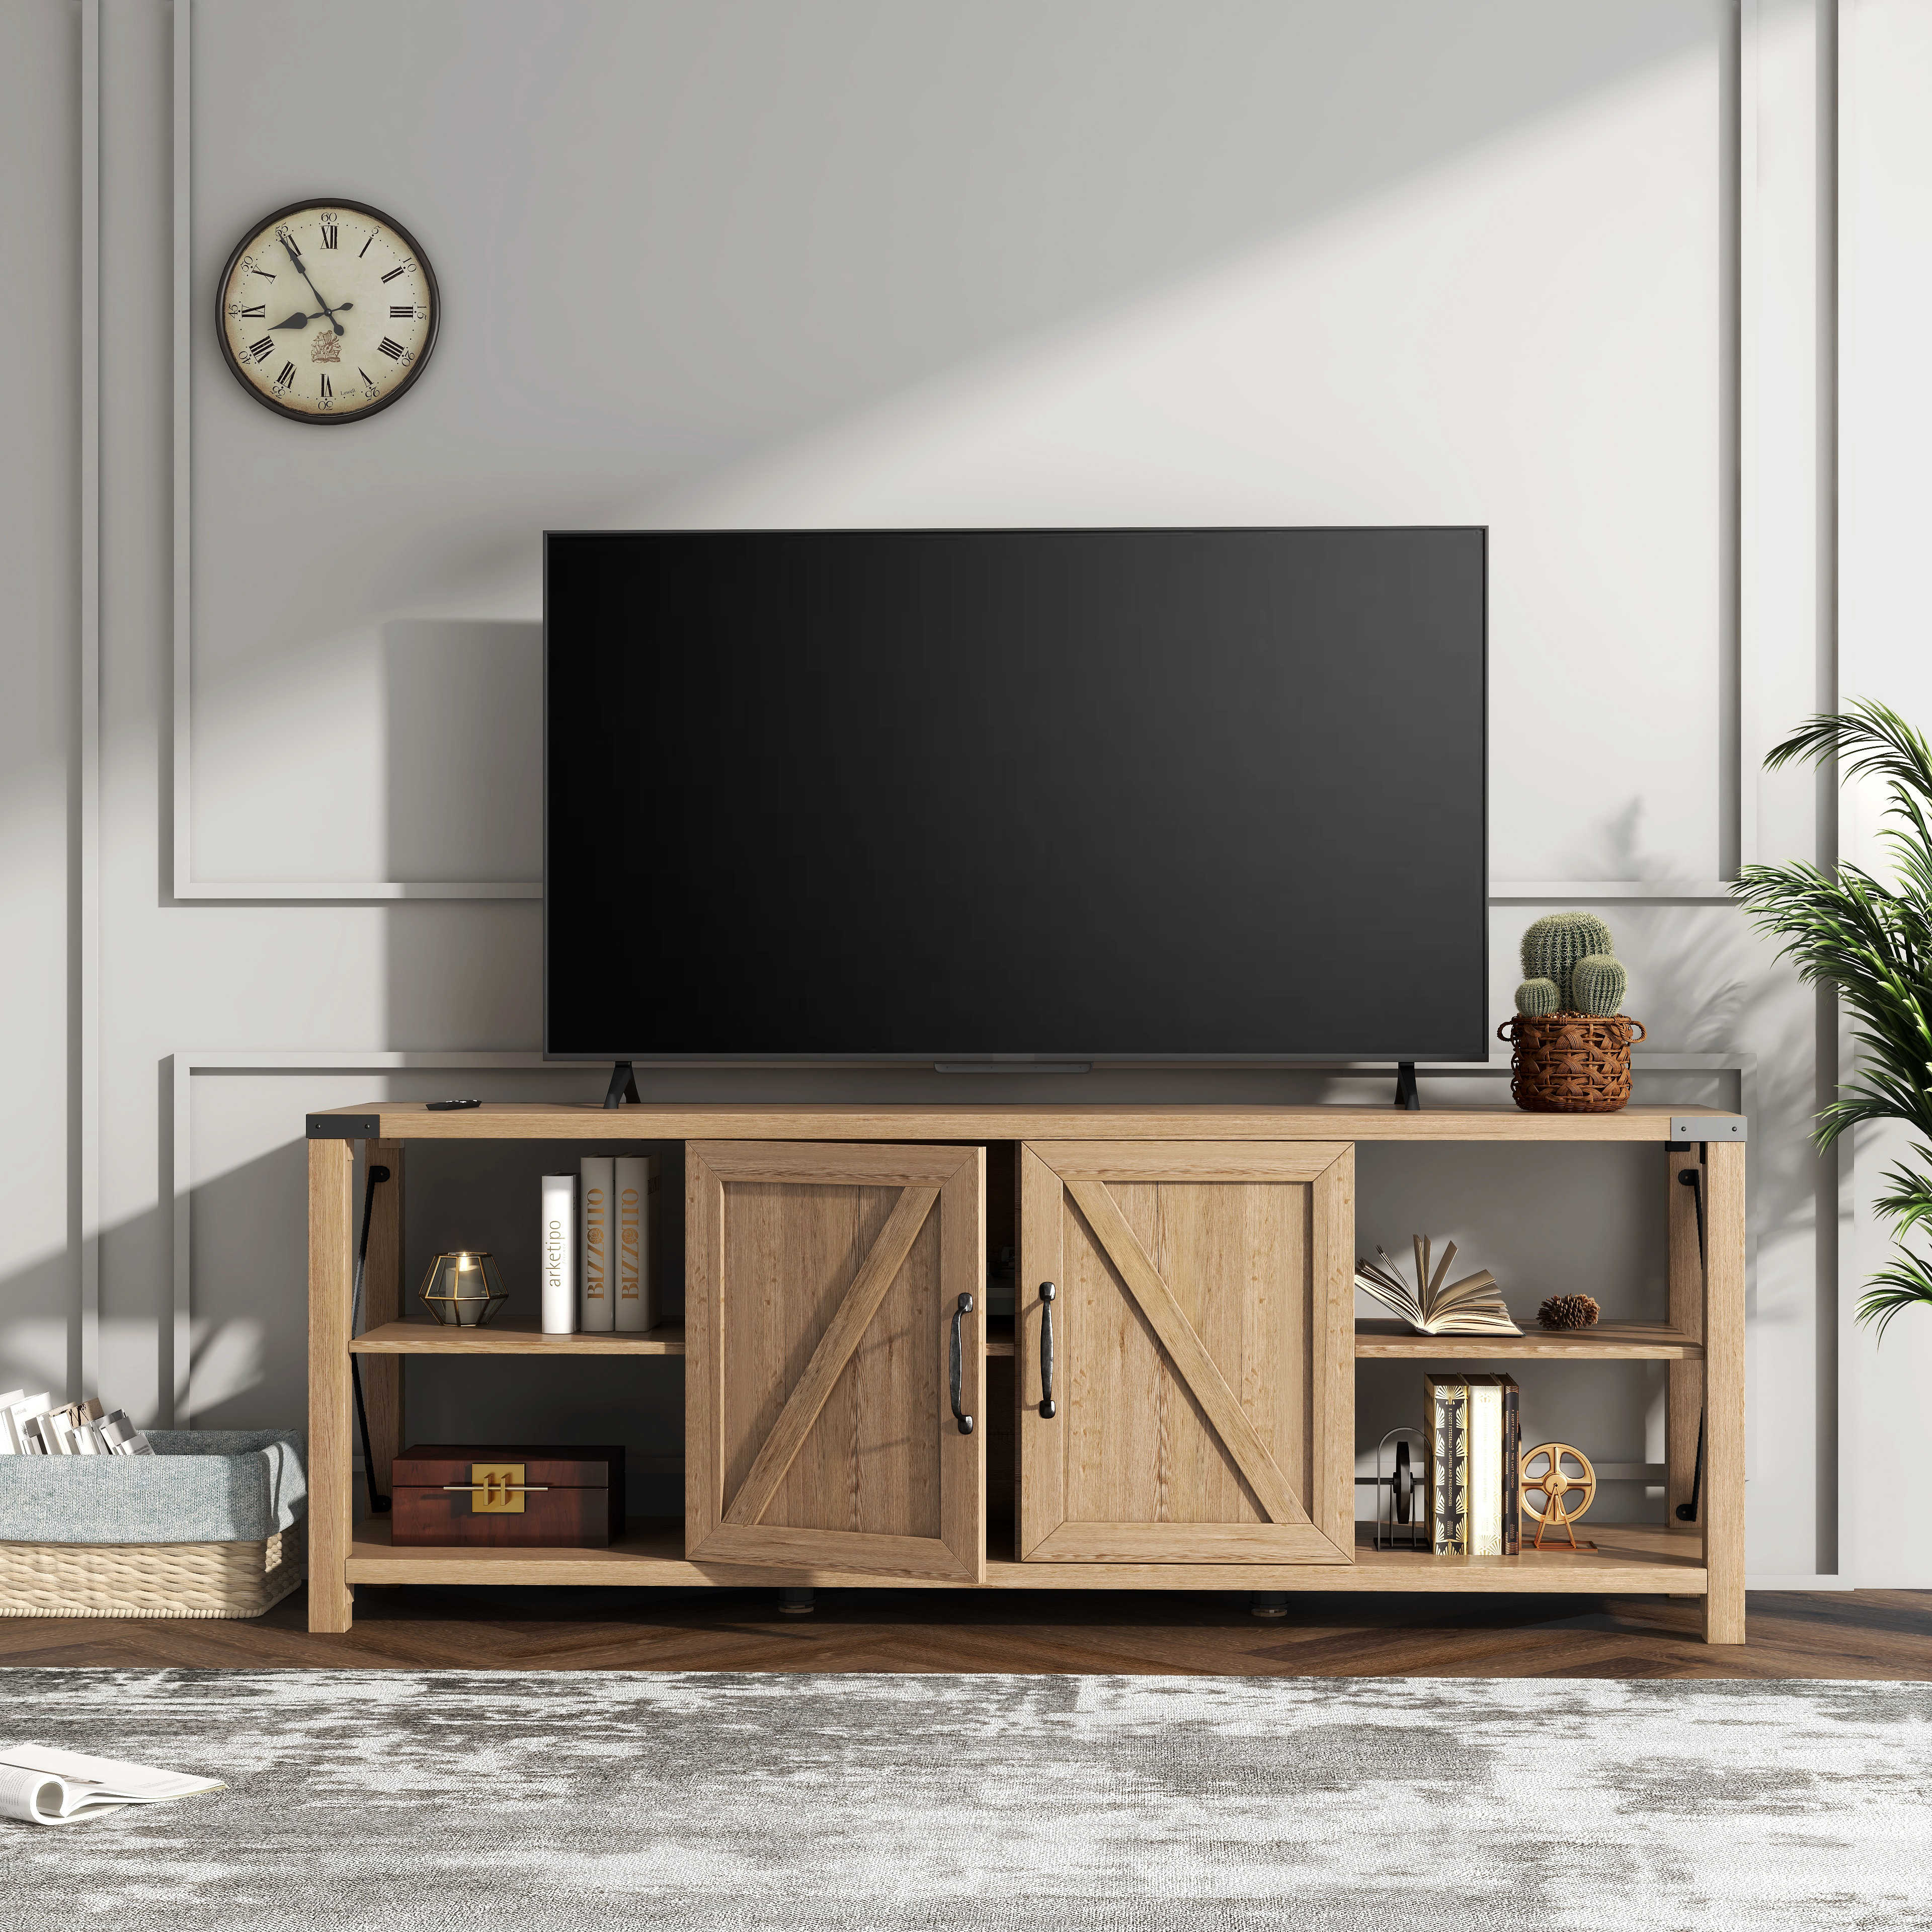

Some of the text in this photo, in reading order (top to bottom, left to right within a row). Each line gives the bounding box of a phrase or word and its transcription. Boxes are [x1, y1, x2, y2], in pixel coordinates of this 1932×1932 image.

[321, 212, 337, 222] 60
[275, 222, 288, 236] 55
[371, 225, 382, 234] 5
[320, 225, 338, 250] XII
[240, 256, 253, 272] 50
[402, 257, 417, 272] 10
[228, 303, 238, 318] 45
[390, 305, 414, 318] III
[417, 305, 427, 320] 15
[238, 351, 251, 365] 40
[401, 352, 415, 367] 20
[272, 385, 286, 399] 35
[341, 387, 356, 395] Lowell
[365, 386, 379, 401] 25
[318, 400, 334, 411] 30
[545, 1221, 566, 1287] arketipo
